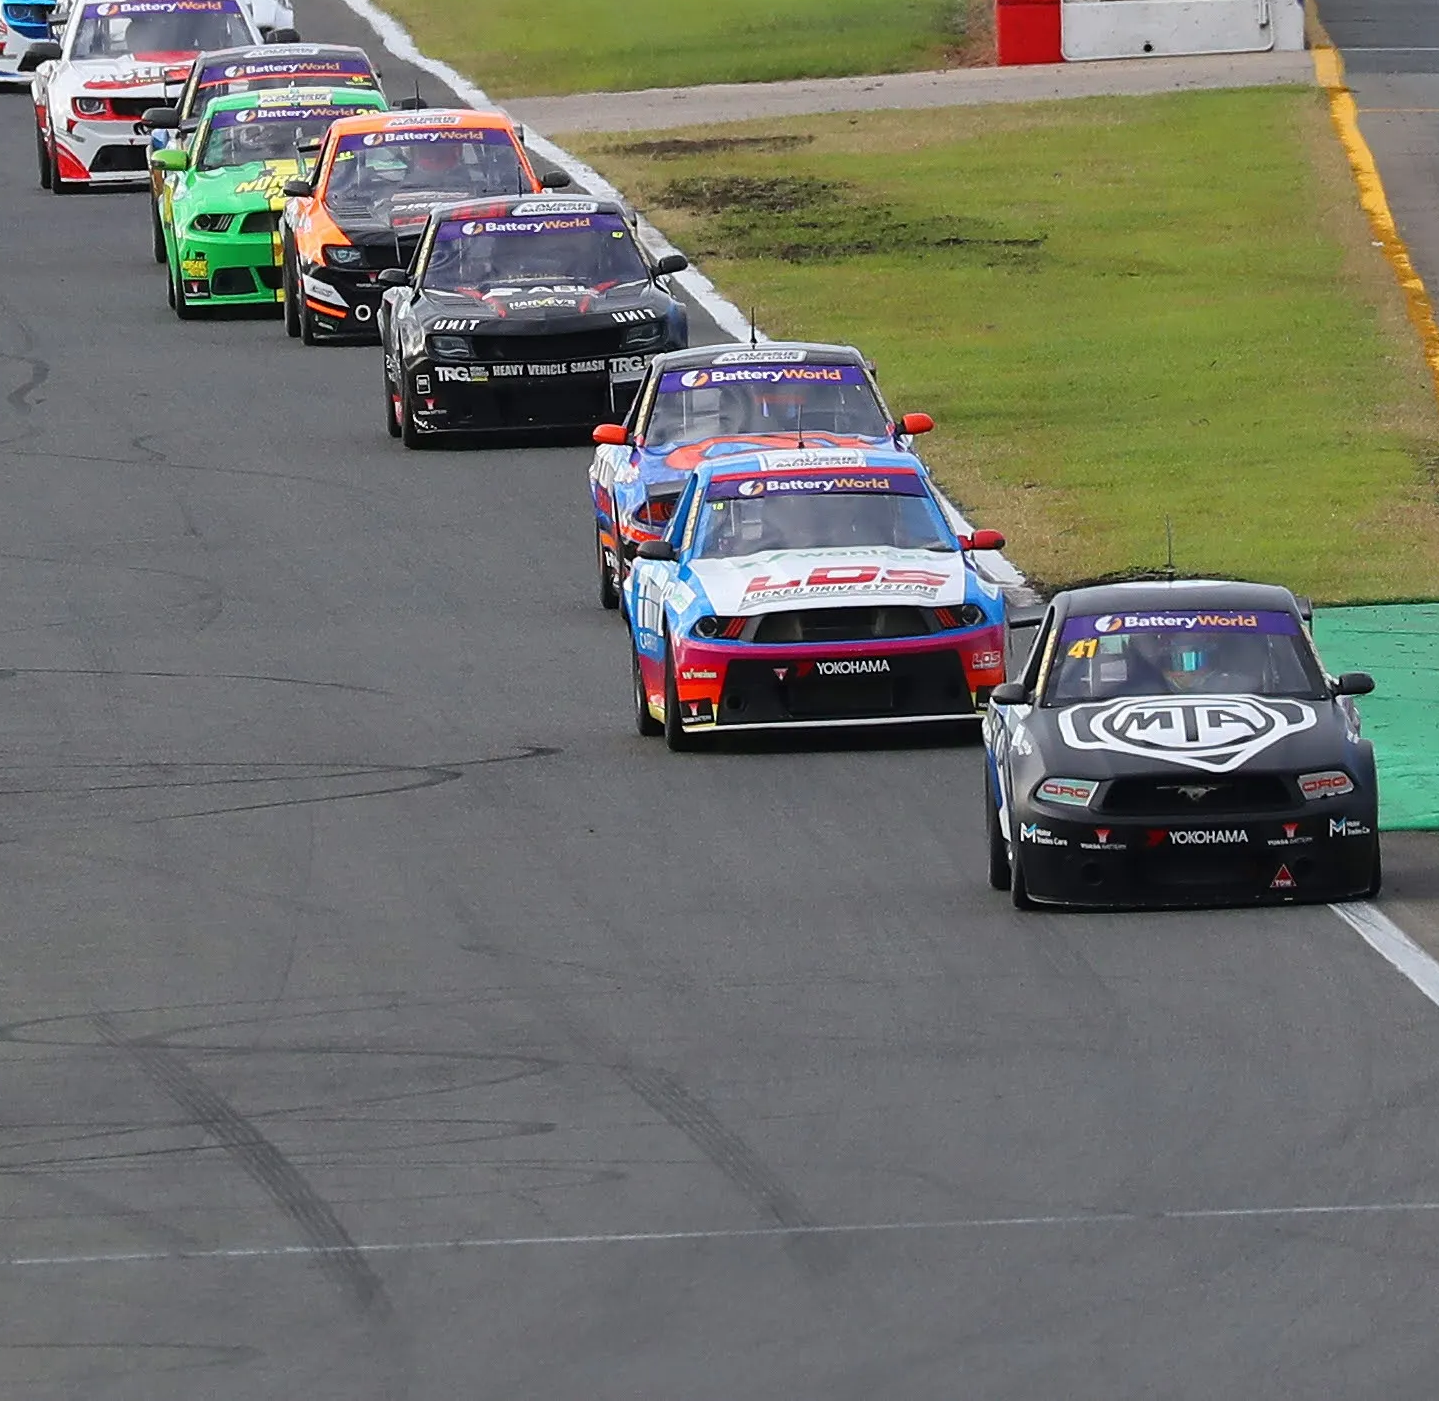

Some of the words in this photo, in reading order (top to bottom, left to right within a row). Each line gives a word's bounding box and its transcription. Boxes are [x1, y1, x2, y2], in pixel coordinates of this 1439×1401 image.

[611, 308, 657, 323] UNIT
[433, 319, 480, 331] UNIT
[492, 365, 524, 377] HEAVY
[526, 362, 568, 377] VEHICLE
[570, 359, 605, 373] SMASH
[746, 565, 952, 593] LDS
[809, 584, 857, 594] DRIVE
[861, 584, 939, 594] SYSTEMS
[1067, 638, 1100, 659] 41
[816, 659, 891, 675] YOKOHAMA
[1115, 704, 1262, 743] MTA
[1169, 829, 1249, 845] YOKOHAMA
